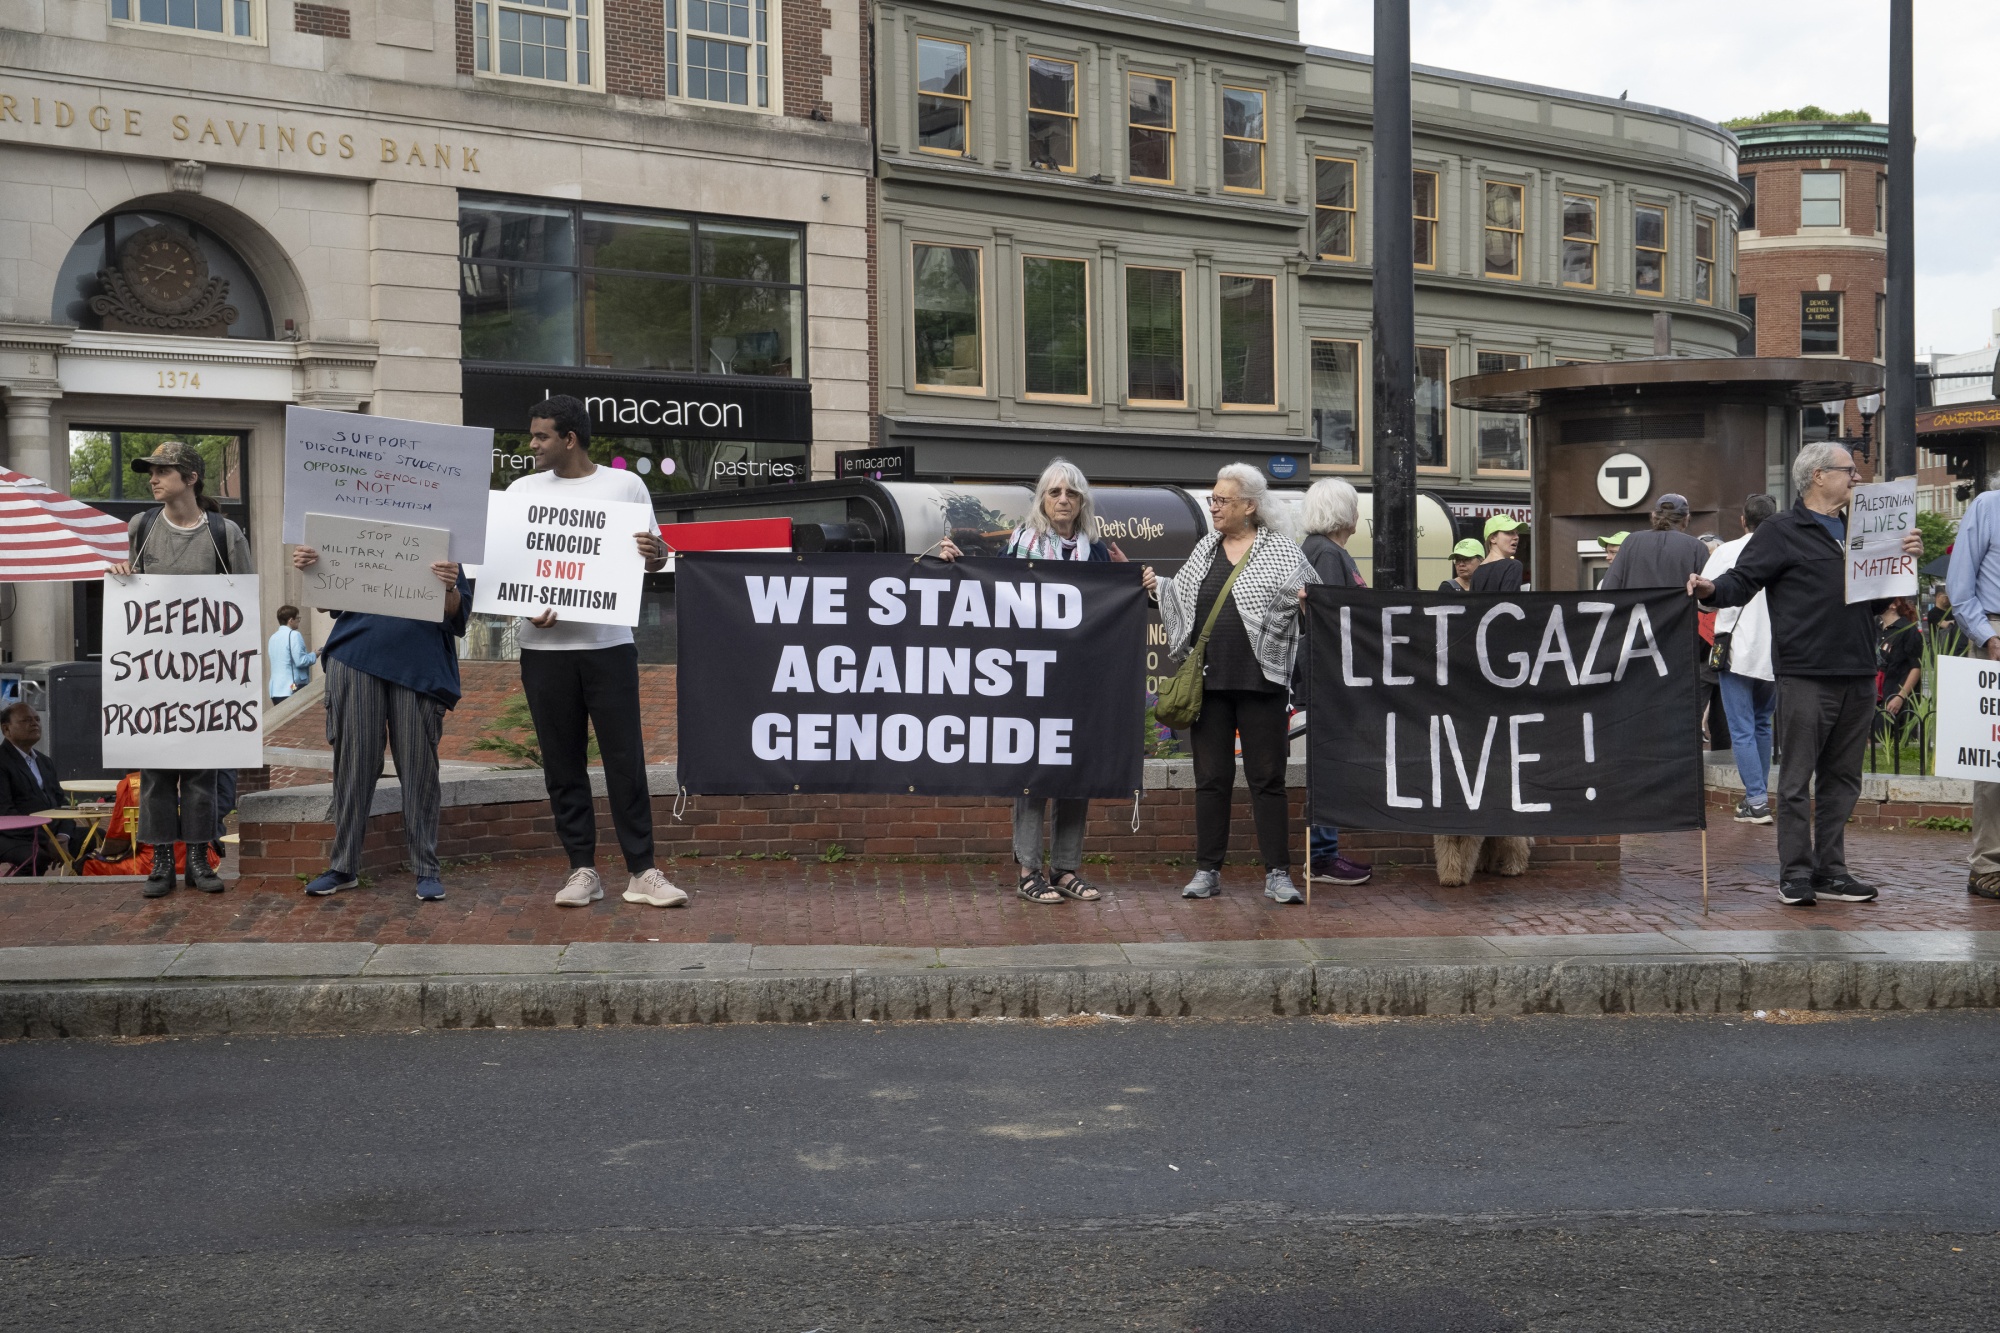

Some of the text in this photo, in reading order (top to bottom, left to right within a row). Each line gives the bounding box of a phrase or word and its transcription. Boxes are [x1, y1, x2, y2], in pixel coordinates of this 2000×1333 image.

[0, 94, 480, 173] RIDGE SAVINGS BANK
[157, 371, 200, 389] 1374
[585, 396, 743, 428] macaron
[1934, 409, 2000, 427] CAMBRIDGE
[332, 431, 422, 450] SUPPORT
[303, 460, 441, 490] OPPOSING GENOCIDE
[395, 454, 462, 477] STUDENTS
[714, 459, 794, 479] pastries
[844, 456, 902, 470] le macaron
[335, 478, 395, 495] IS NOT
[1605, 466, 1642, 499] T
[335, 493, 432, 511] ANTI-SEMITISM
[1854, 492, 1915, 512] PALESTINIAN
[528, 505, 606, 529] OPPOSING
[1094, 515, 1164, 541] Peet's Coffee
[1862, 512, 1908, 534] LIVES
[357, 530, 392, 542] STOP
[526, 531, 602, 555] GENOCIDE
[322, 544, 420, 562] MILITARY AID
[354, 562, 393, 571] ISRAEL
[536, 559, 586, 580] IS NOT
[1853, 555, 1914, 580] MATTER
[314, 573, 438, 601] STOP THE KILLING
[497, 582, 617, 610] ANTI-SEMITISM
[744, 575, 1083, 630] WE STAND
[124, 597, 244, 636] DEFEND
[1339, 602, 1669, 688] LET GAZA
[110, 649, 258, 686] STUDENT
[771, 644, 1058, 697] AGAINST
[1979, 671, 2000, 690] OP
[103, 699, 258, 737] PROTESTERS
[1980, 697, 2000, 716] GE
[751, 712, 1073, 766] GENOCIDE
[1386, 711, 1552, 812] LIVE
